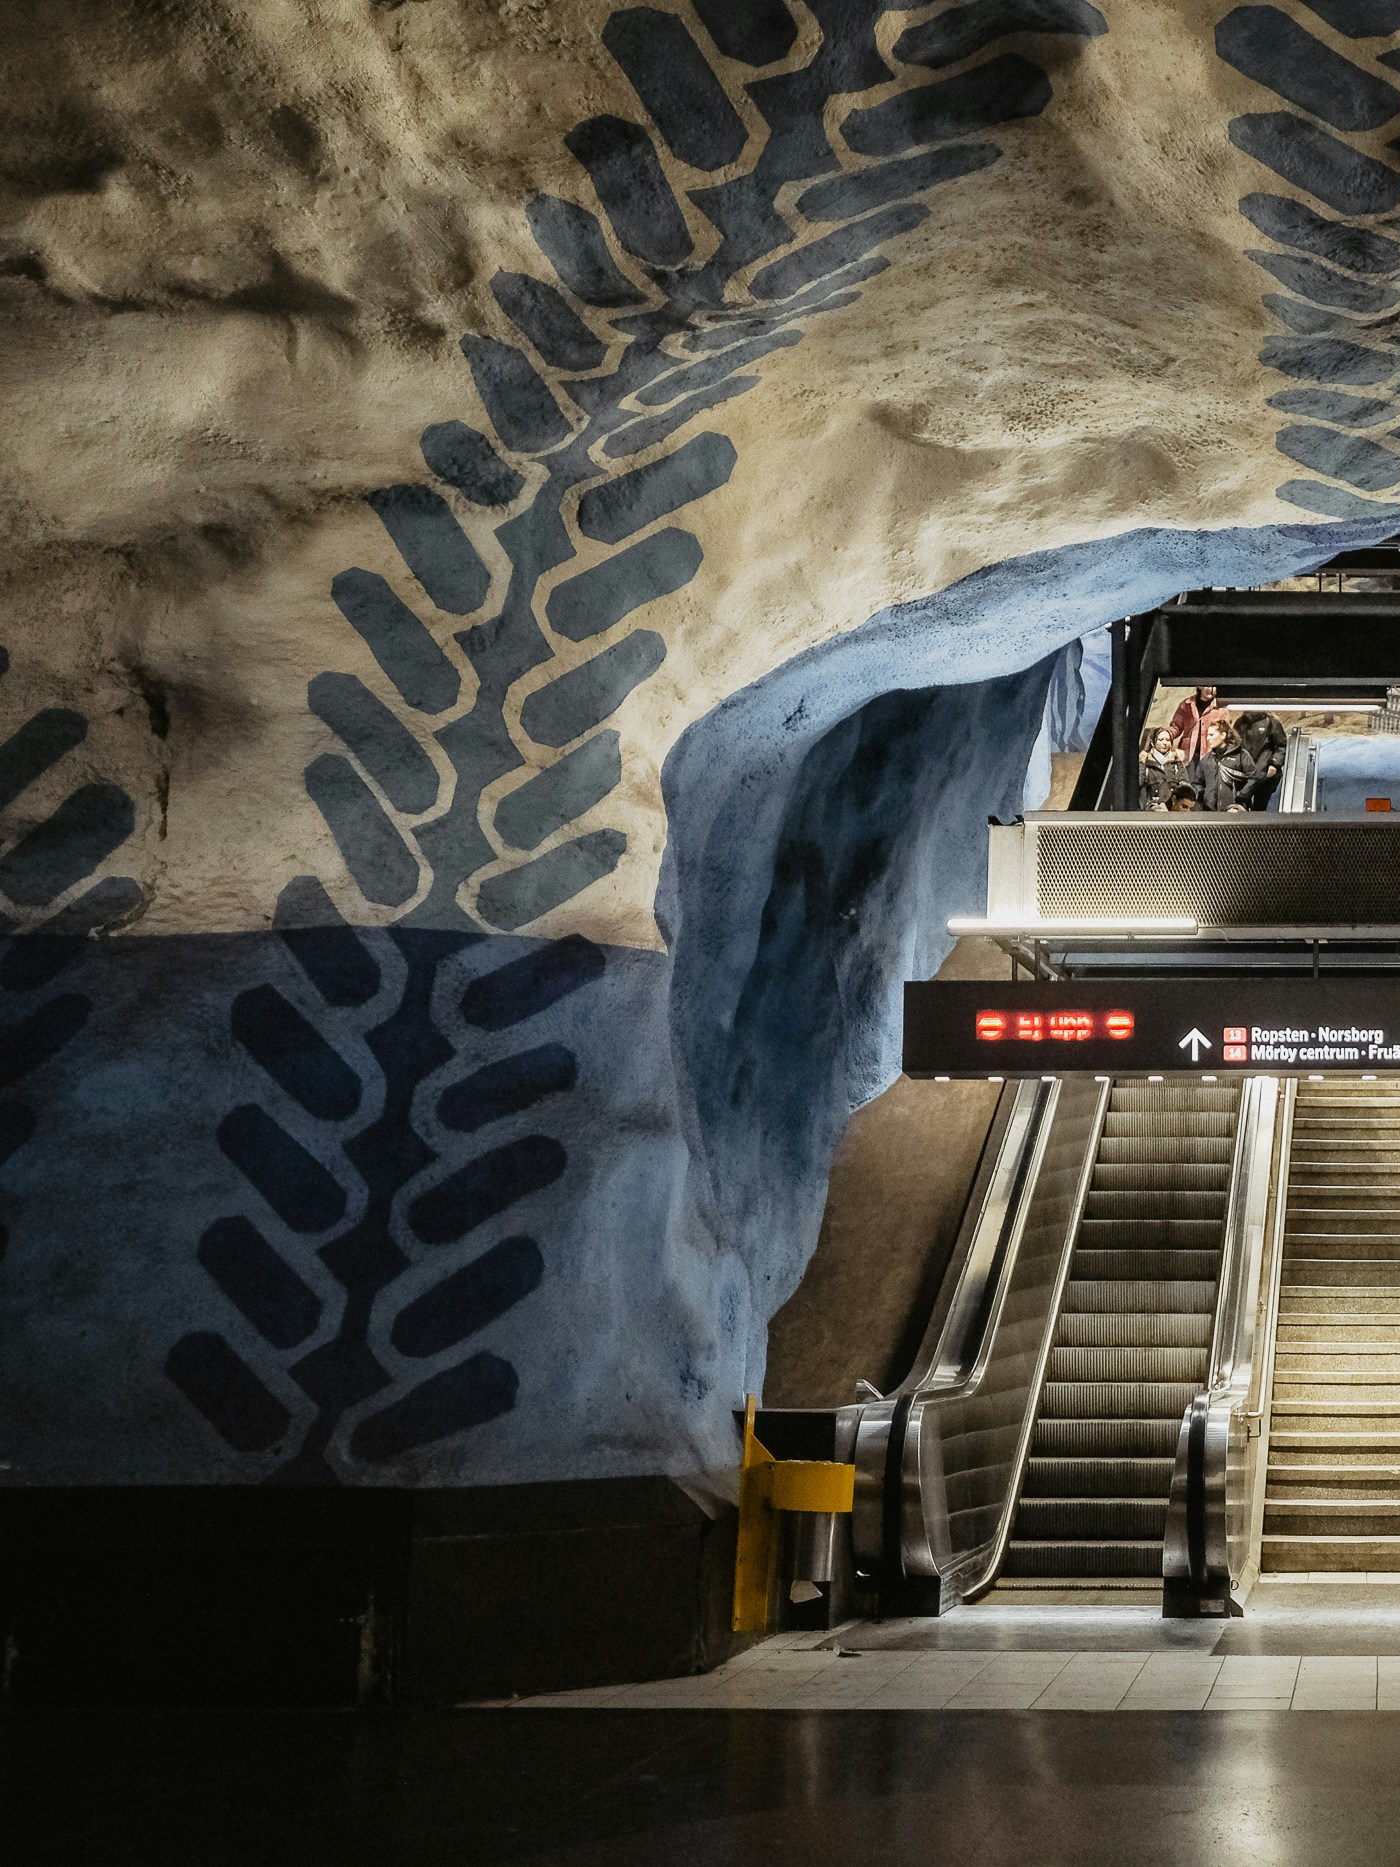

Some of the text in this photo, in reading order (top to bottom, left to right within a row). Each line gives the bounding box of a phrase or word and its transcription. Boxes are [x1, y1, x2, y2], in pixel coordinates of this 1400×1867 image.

[1229, 1027, 1384, 1045] 13 Ropsten Norsborg
[1229, 1047, 1242, 1059] 14
[1251, 1044, 1298, 1063] Mörby
[1299, 1045, 1360, 1060] centrum
